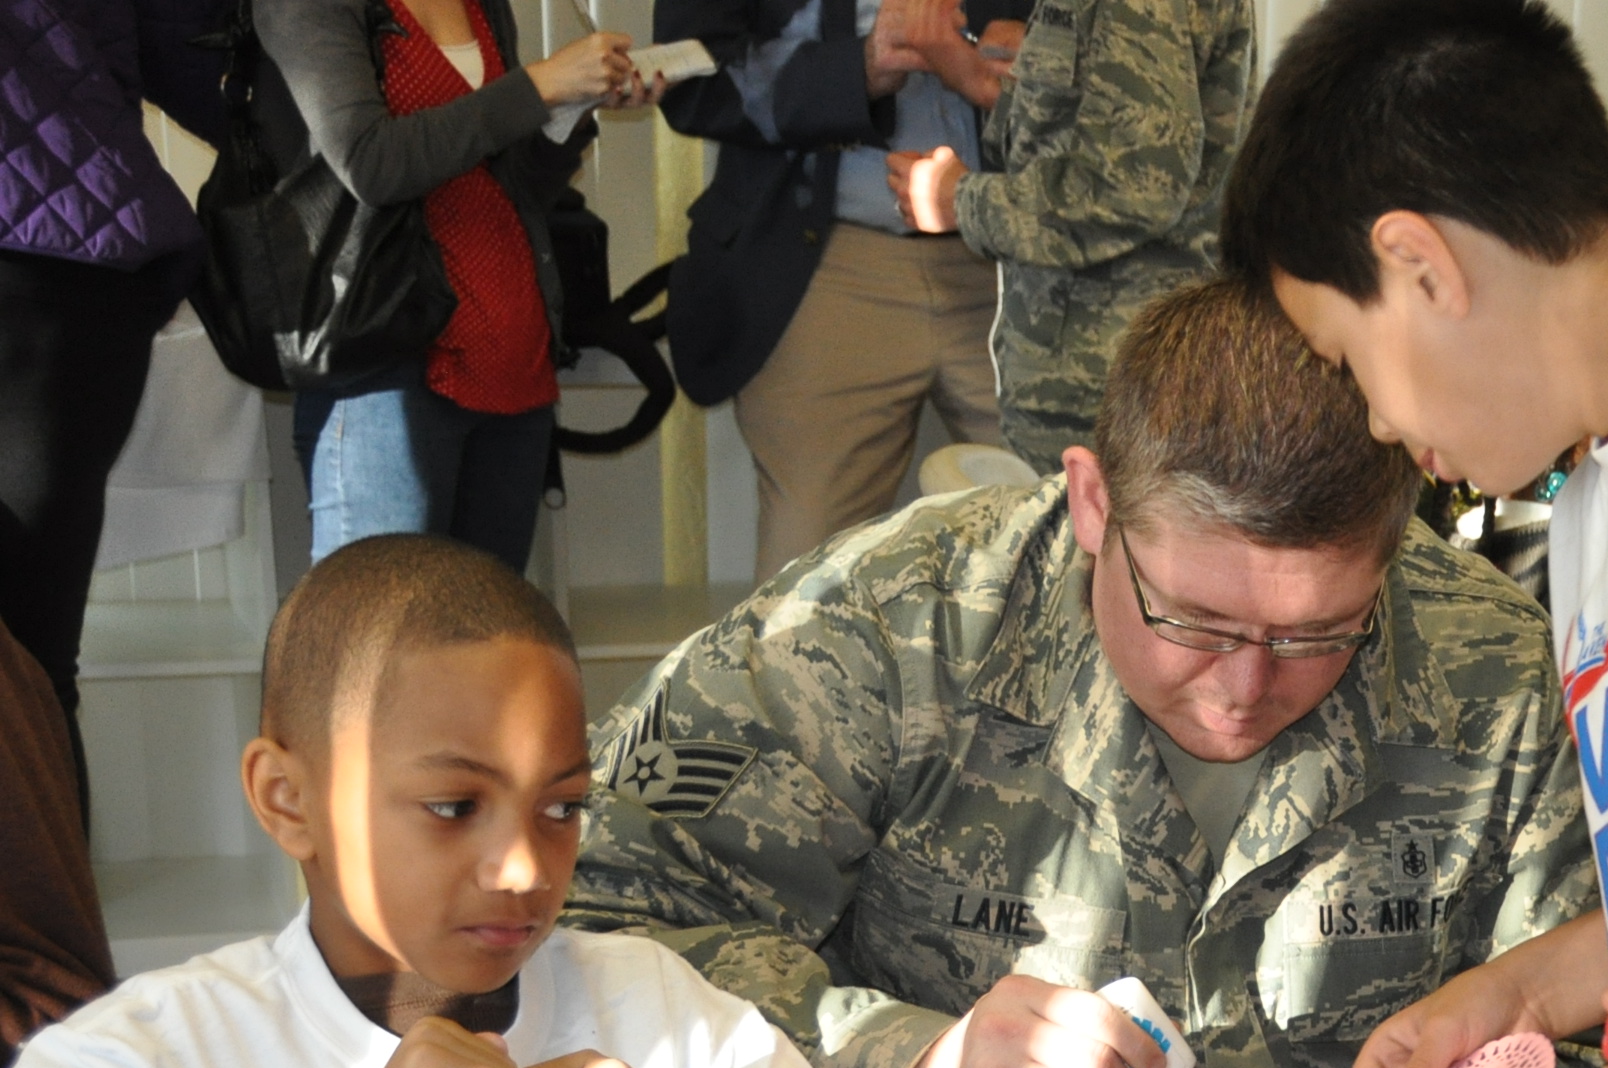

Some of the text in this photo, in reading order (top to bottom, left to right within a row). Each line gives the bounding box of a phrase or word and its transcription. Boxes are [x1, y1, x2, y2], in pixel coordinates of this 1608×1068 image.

[952, 893, 1035, 938] LANE
[1319, 902, 1366, 937] U.S.
[1379, 897, 1420, 934] AIR
